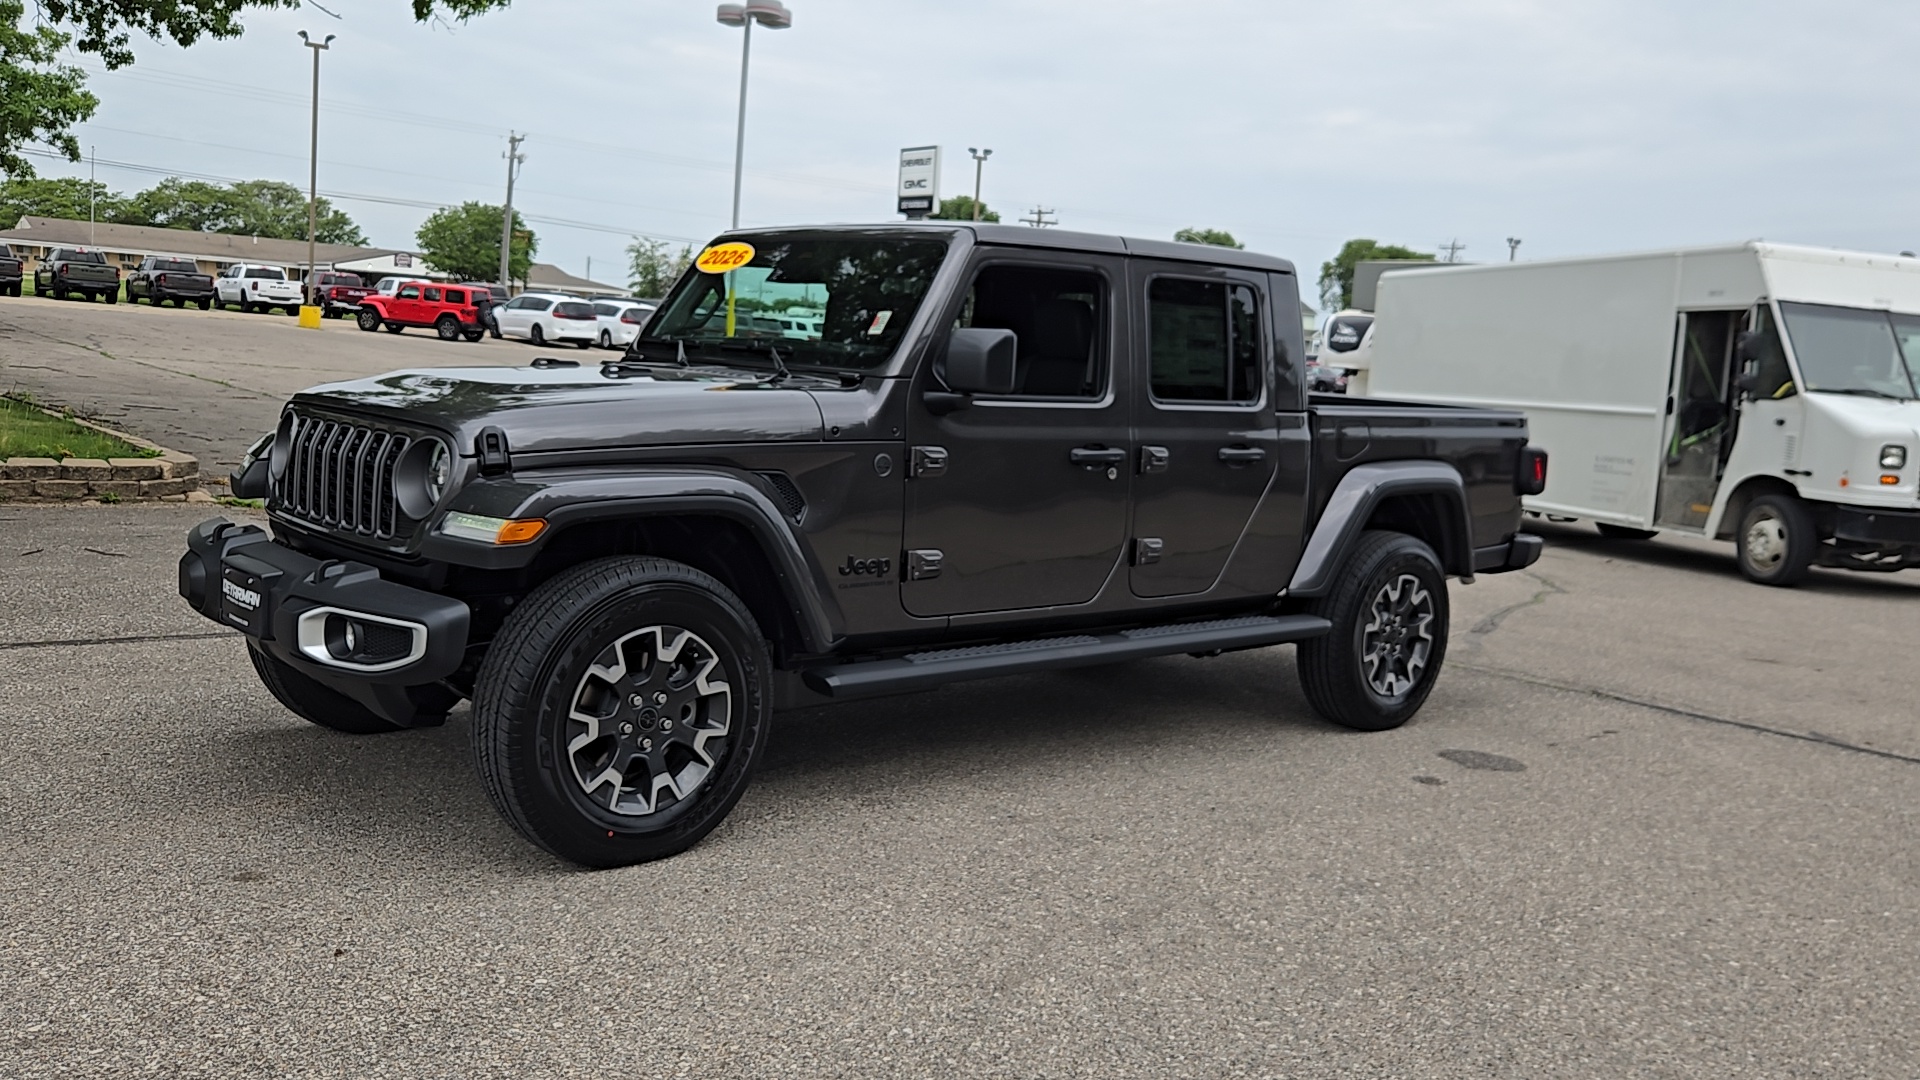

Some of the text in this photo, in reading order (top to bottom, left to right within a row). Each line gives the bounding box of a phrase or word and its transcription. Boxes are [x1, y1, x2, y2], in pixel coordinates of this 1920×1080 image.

[904, 179, 928, 189] GMC
[700, 250, 749, 265] 2026
[838, 554, 890, 578] Jeep
